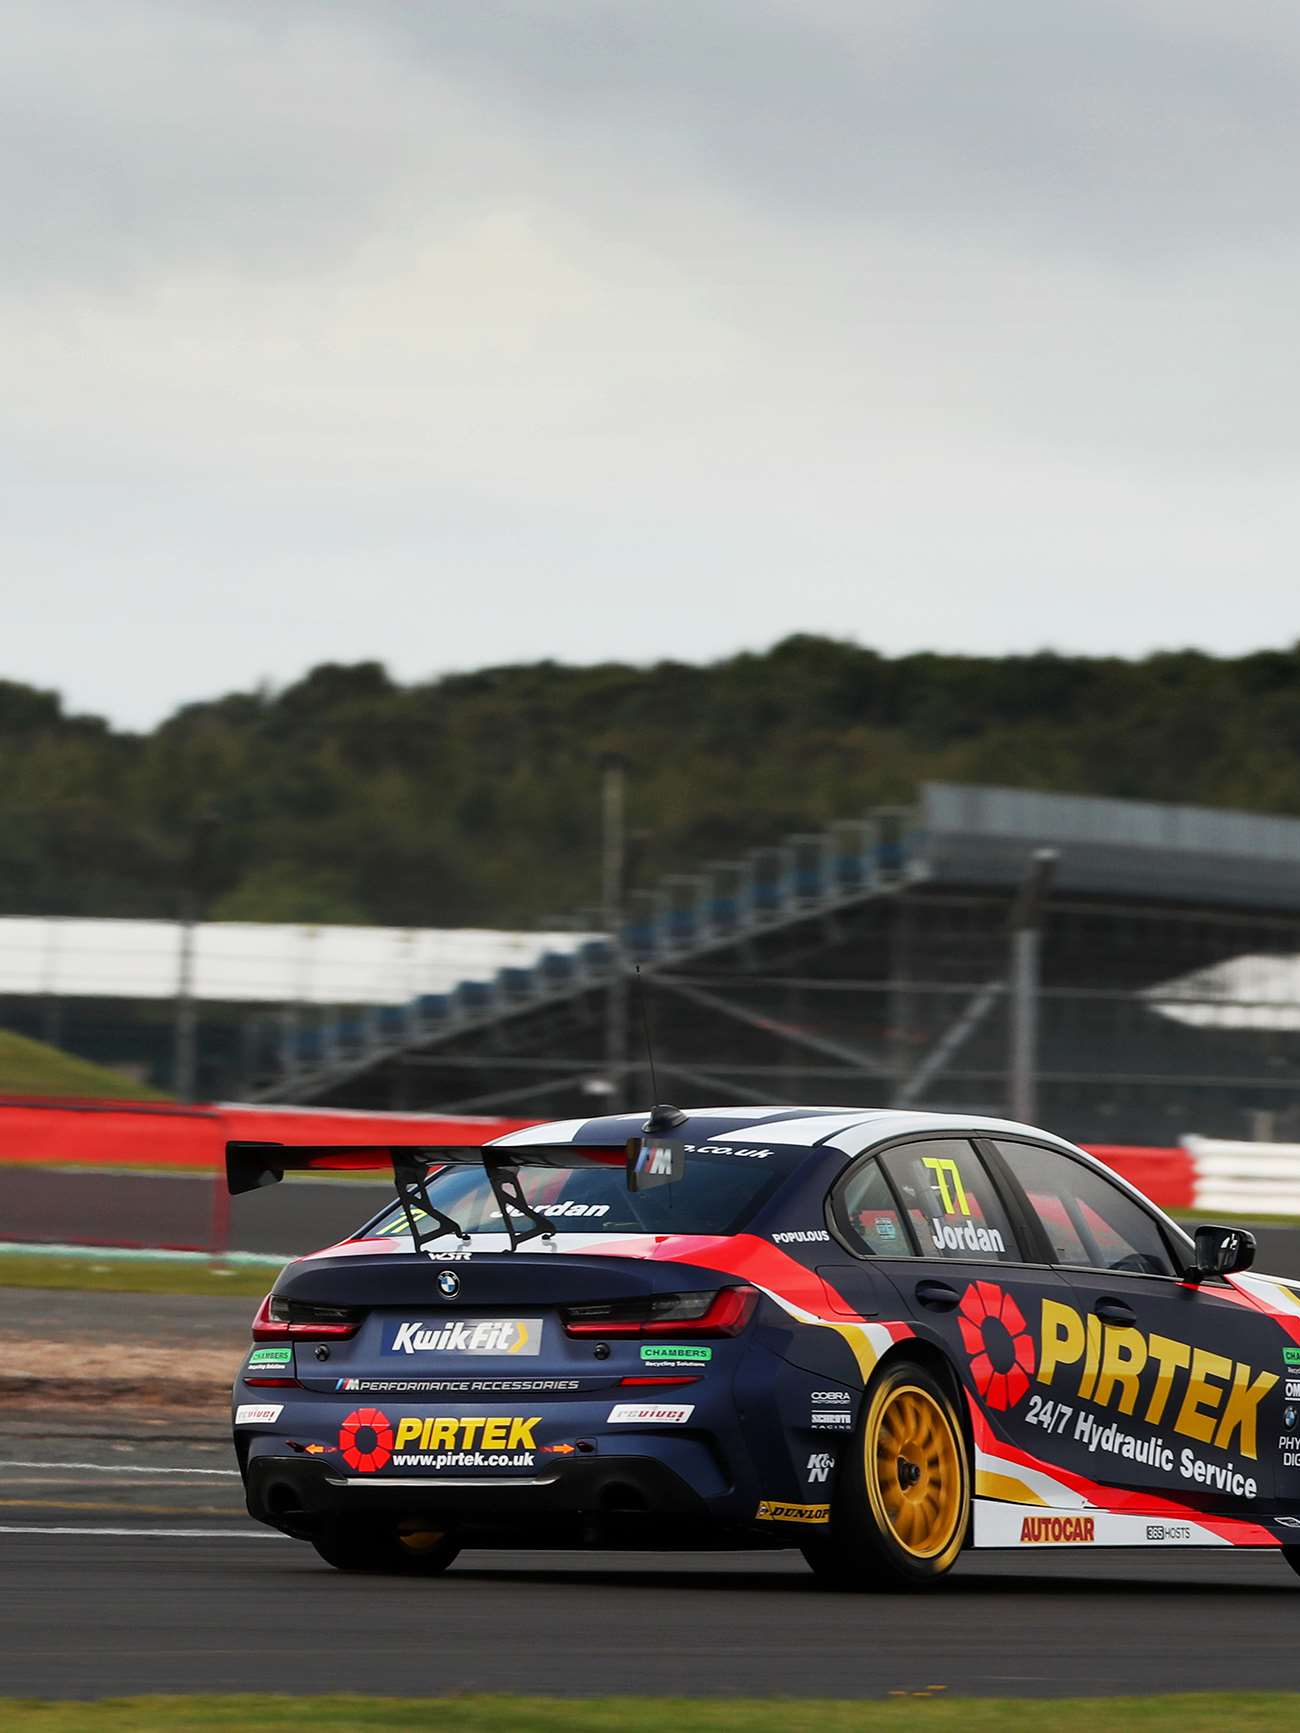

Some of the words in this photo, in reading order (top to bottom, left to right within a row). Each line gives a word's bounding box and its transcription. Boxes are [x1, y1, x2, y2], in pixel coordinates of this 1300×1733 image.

[921, 1157, 971, 1216] 77
[771, 1230, 830, 1244] POPULOUS
[932, 1218, 1005, 1253] Jordan
[644, 1348, 708, 1358] CHAMBERS
[360, 1382, 470, 1391] PERFORMANCE
[471, 1380, 580, 1391] ACCESSORIES
[1035, 1297, 1281, 1461] PIRTEK
[811, 1391, 850, 1400] COBRA
[394, 1417, 543, 1450] PIRTEK
[1025, 1395, 1073, 1433] 24/7
[1074, 1411, 1174, 1471] Hydraulic
[1180, 1448, 1258, 1499] Service
[393, 1452, 534, 1469] www.pirtek.co.uk
[1020, 1517, 1095, 1542] AUTOCAR
